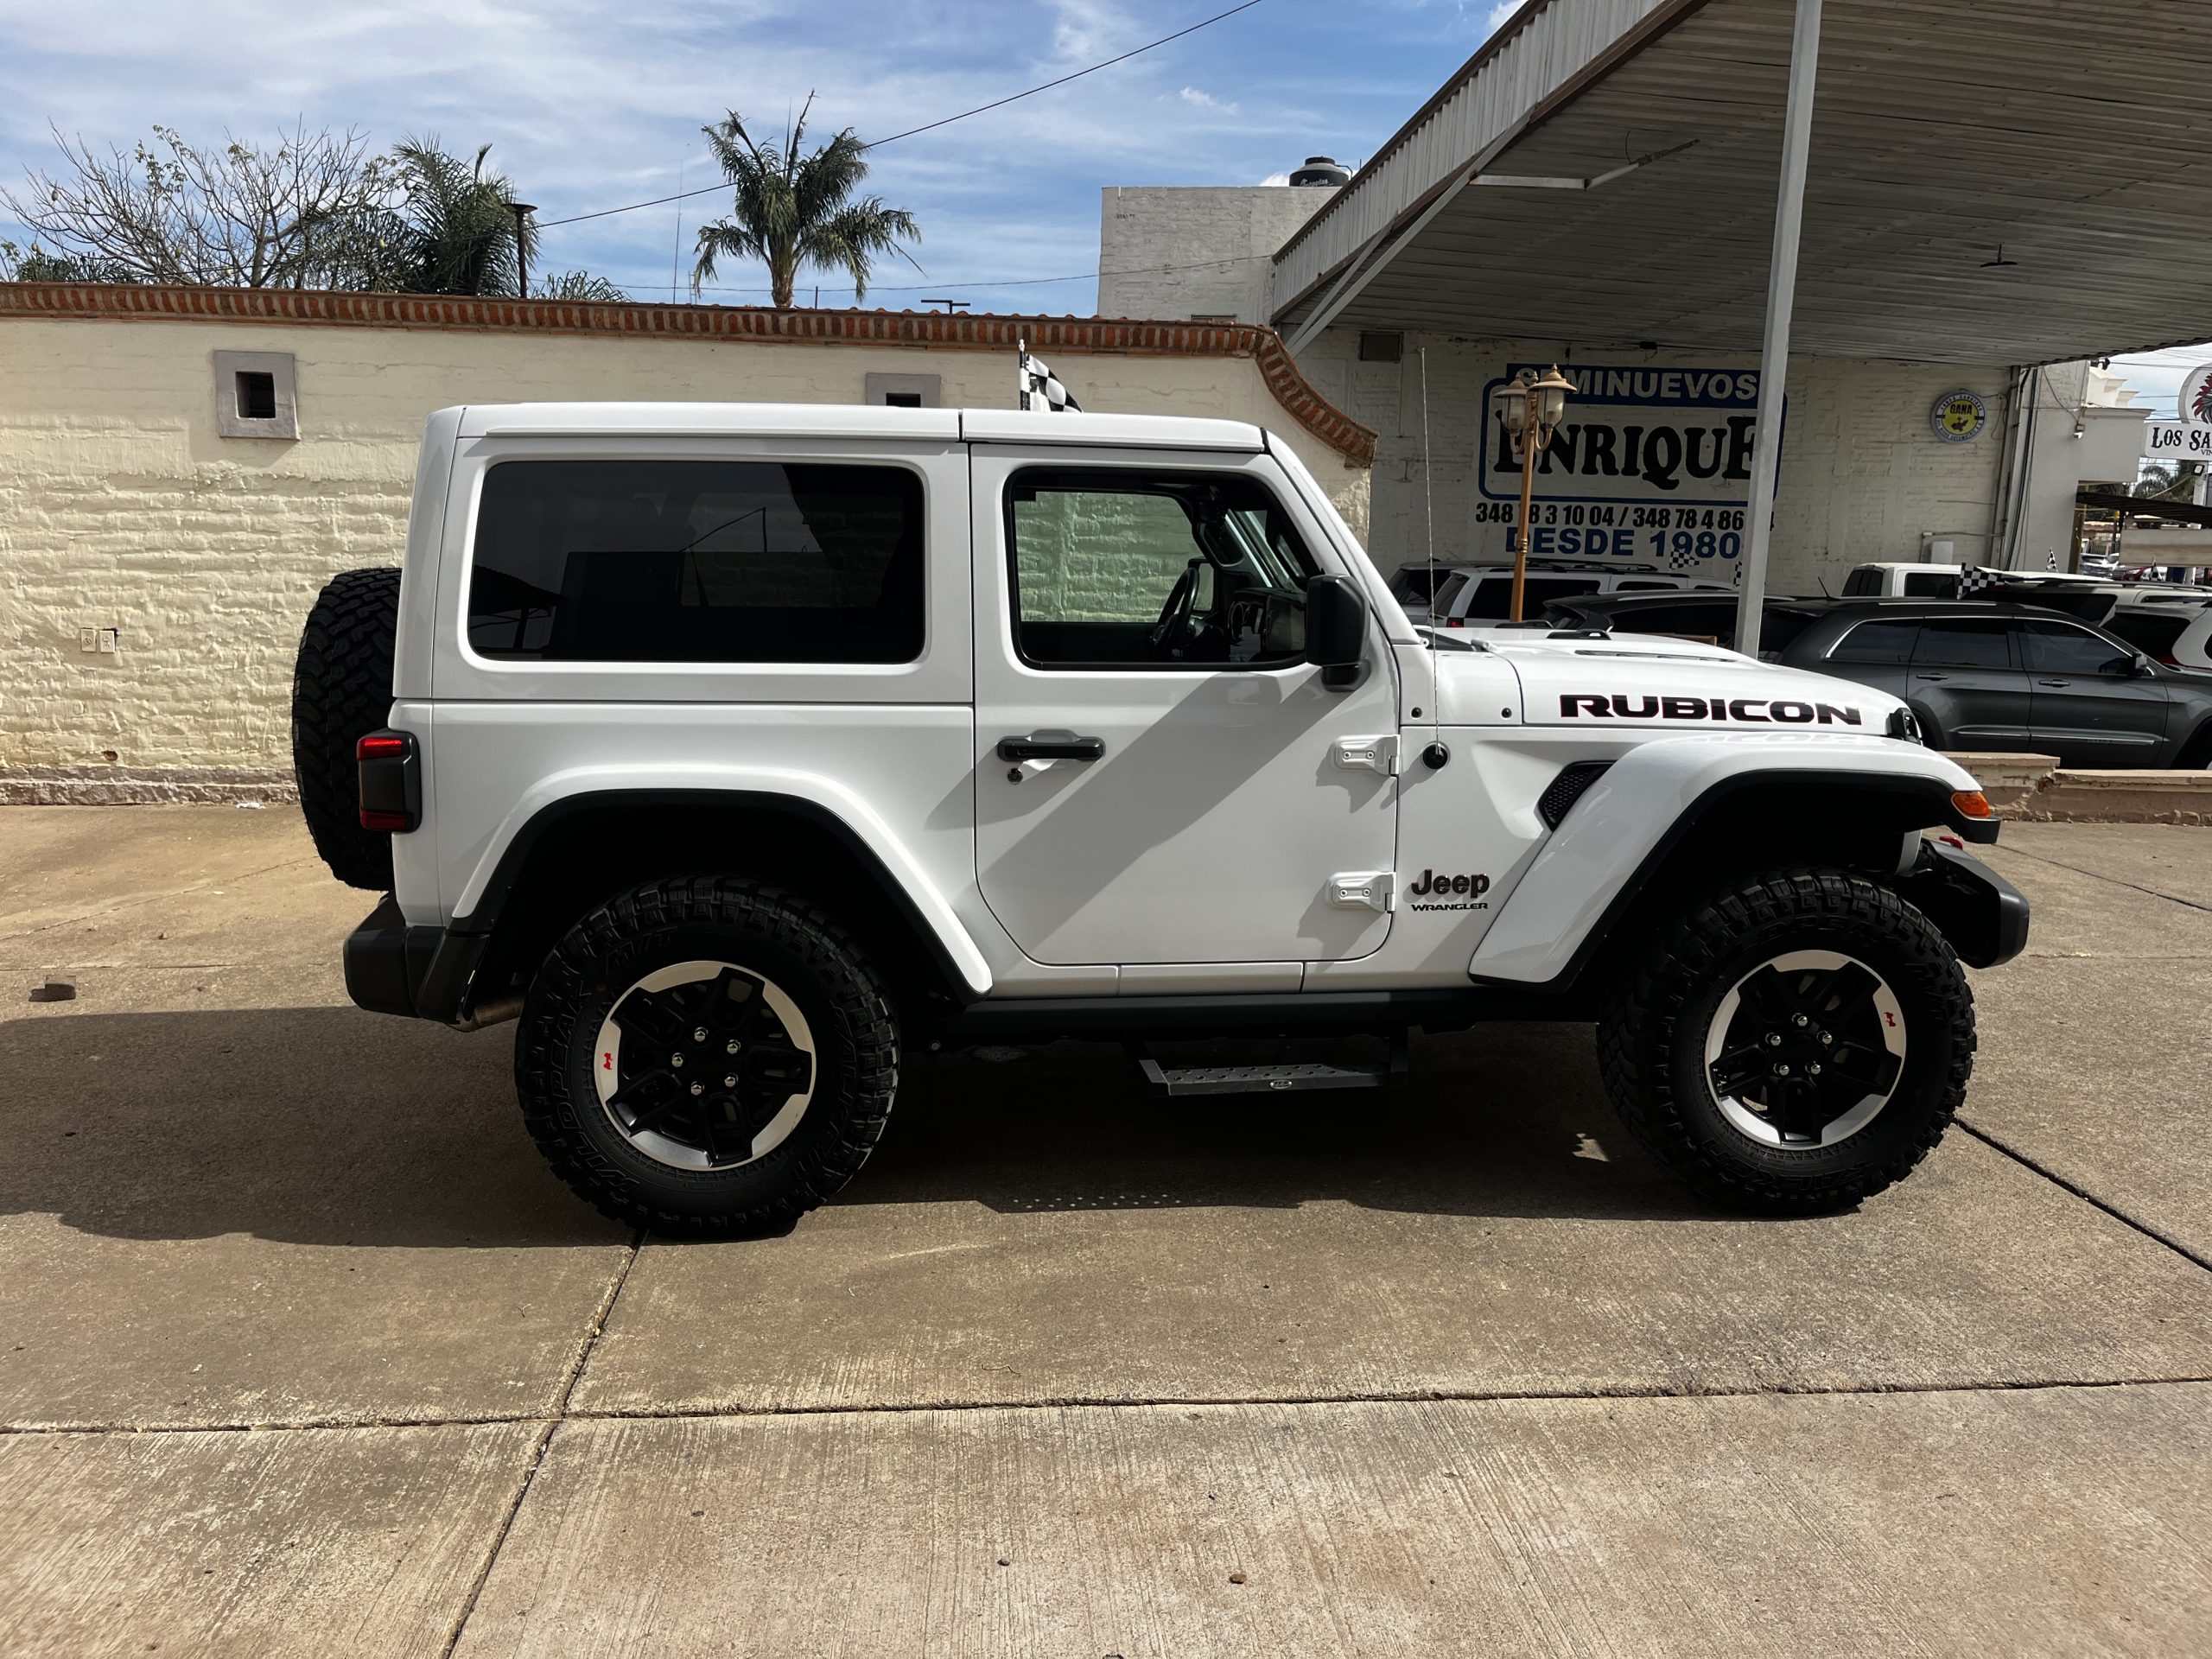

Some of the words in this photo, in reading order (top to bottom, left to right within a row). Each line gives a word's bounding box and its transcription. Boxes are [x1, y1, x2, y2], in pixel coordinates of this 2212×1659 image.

[2150, 427, 2183, 448] LOS
[1476, 503, 1514, 524] 348
[1545, 504, 1558, 524] 3
[1562, 505, 1585, 525] 10
[1591, 505, 1615, 526] 04
[1633, 507, 1670, 529] 348
[1675, 508, 1697, 530] 78
[1700, 509, 1713, 530] 4
[1717, 510, 1745, 531] 86
[1649, 530, 1741, 559] 1980
[1559, 694, 1862, 726] RUBICON
[1411, 868, 1490, 899] Jeep
[1411, 903, 1489, 912] WRANGLER
